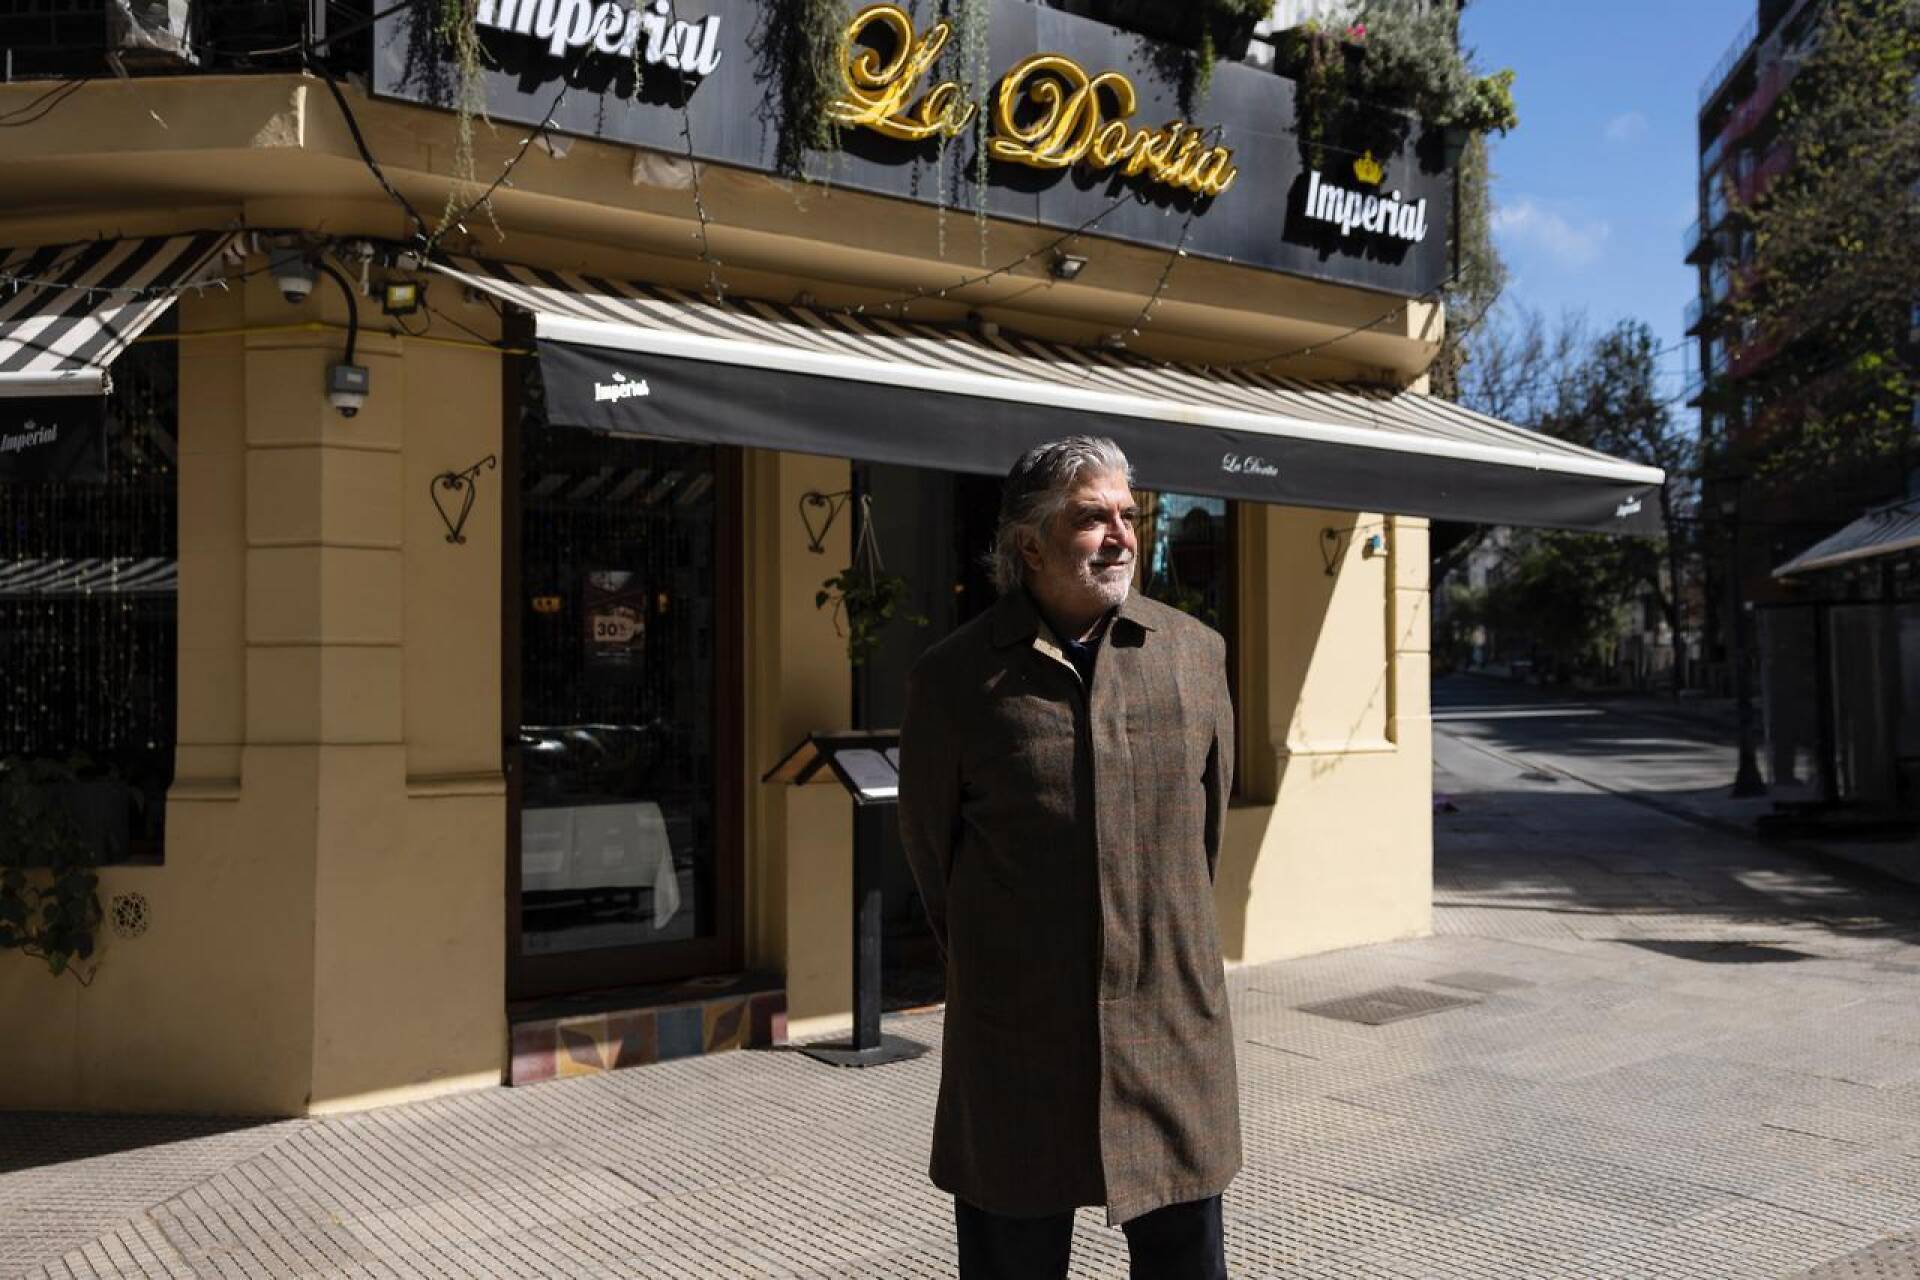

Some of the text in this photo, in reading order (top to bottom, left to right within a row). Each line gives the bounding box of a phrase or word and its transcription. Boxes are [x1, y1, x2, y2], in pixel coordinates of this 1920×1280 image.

[825, 4, 1238, 195] La Dorita
[1305, 170, 1428, 242] Imperial
